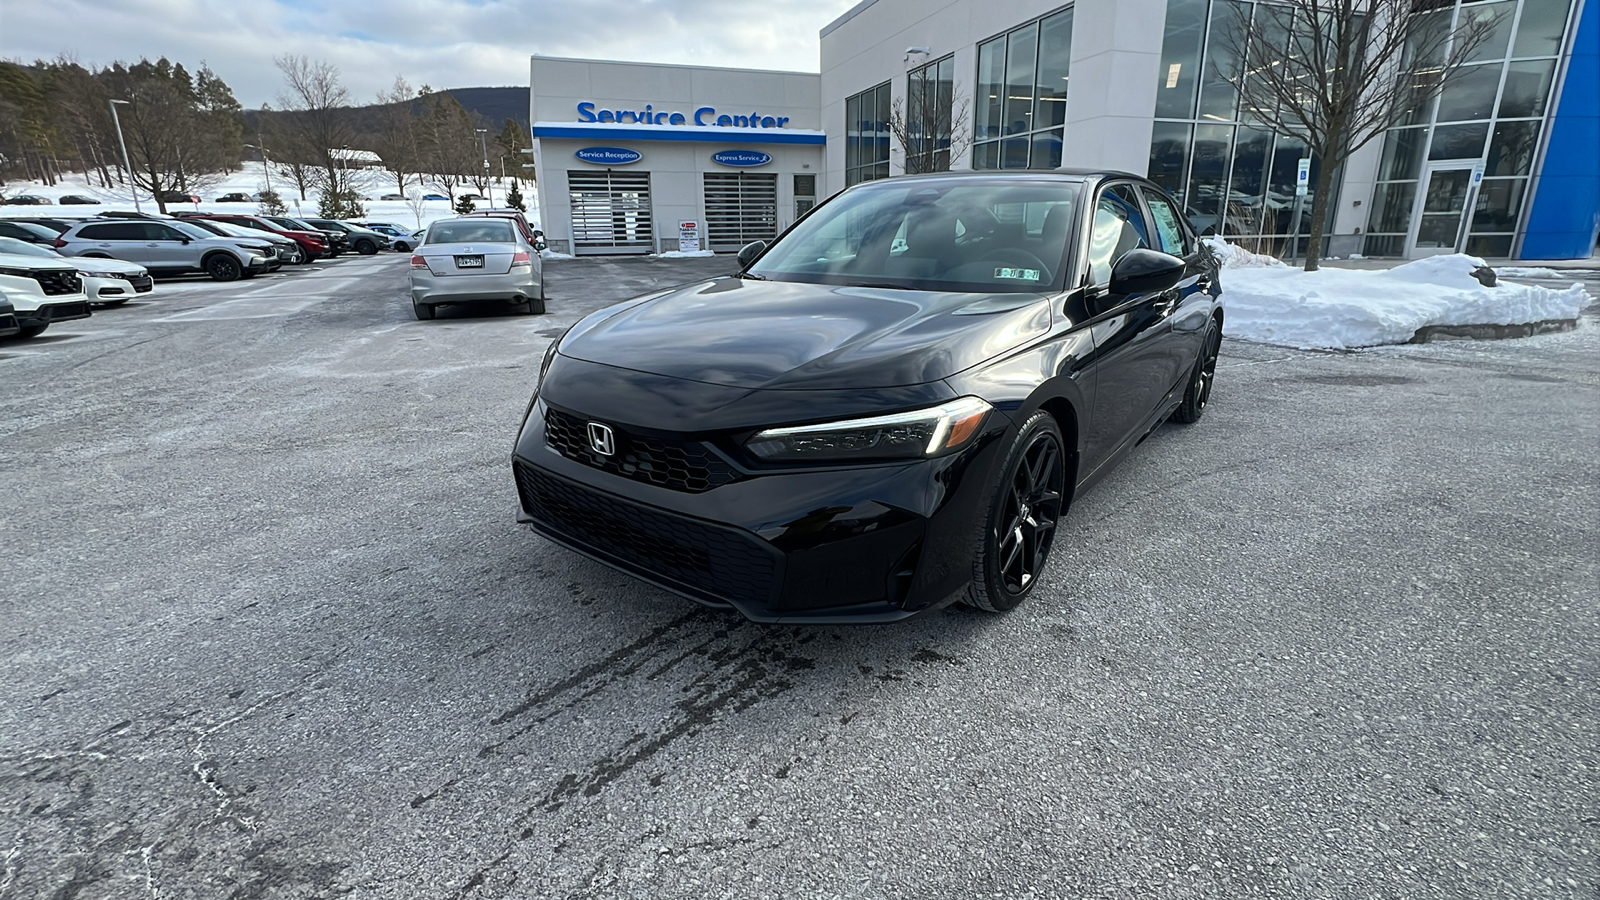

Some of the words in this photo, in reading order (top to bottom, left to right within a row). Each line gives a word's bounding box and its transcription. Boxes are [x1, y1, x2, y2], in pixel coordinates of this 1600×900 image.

[577, 101, 685, 126] Service
[694, 106, 790, 129] Center
[579, 151, 604, 159] Service
[605, 151, 638, 161] Reception
[715, 154, 738, 163] Express
